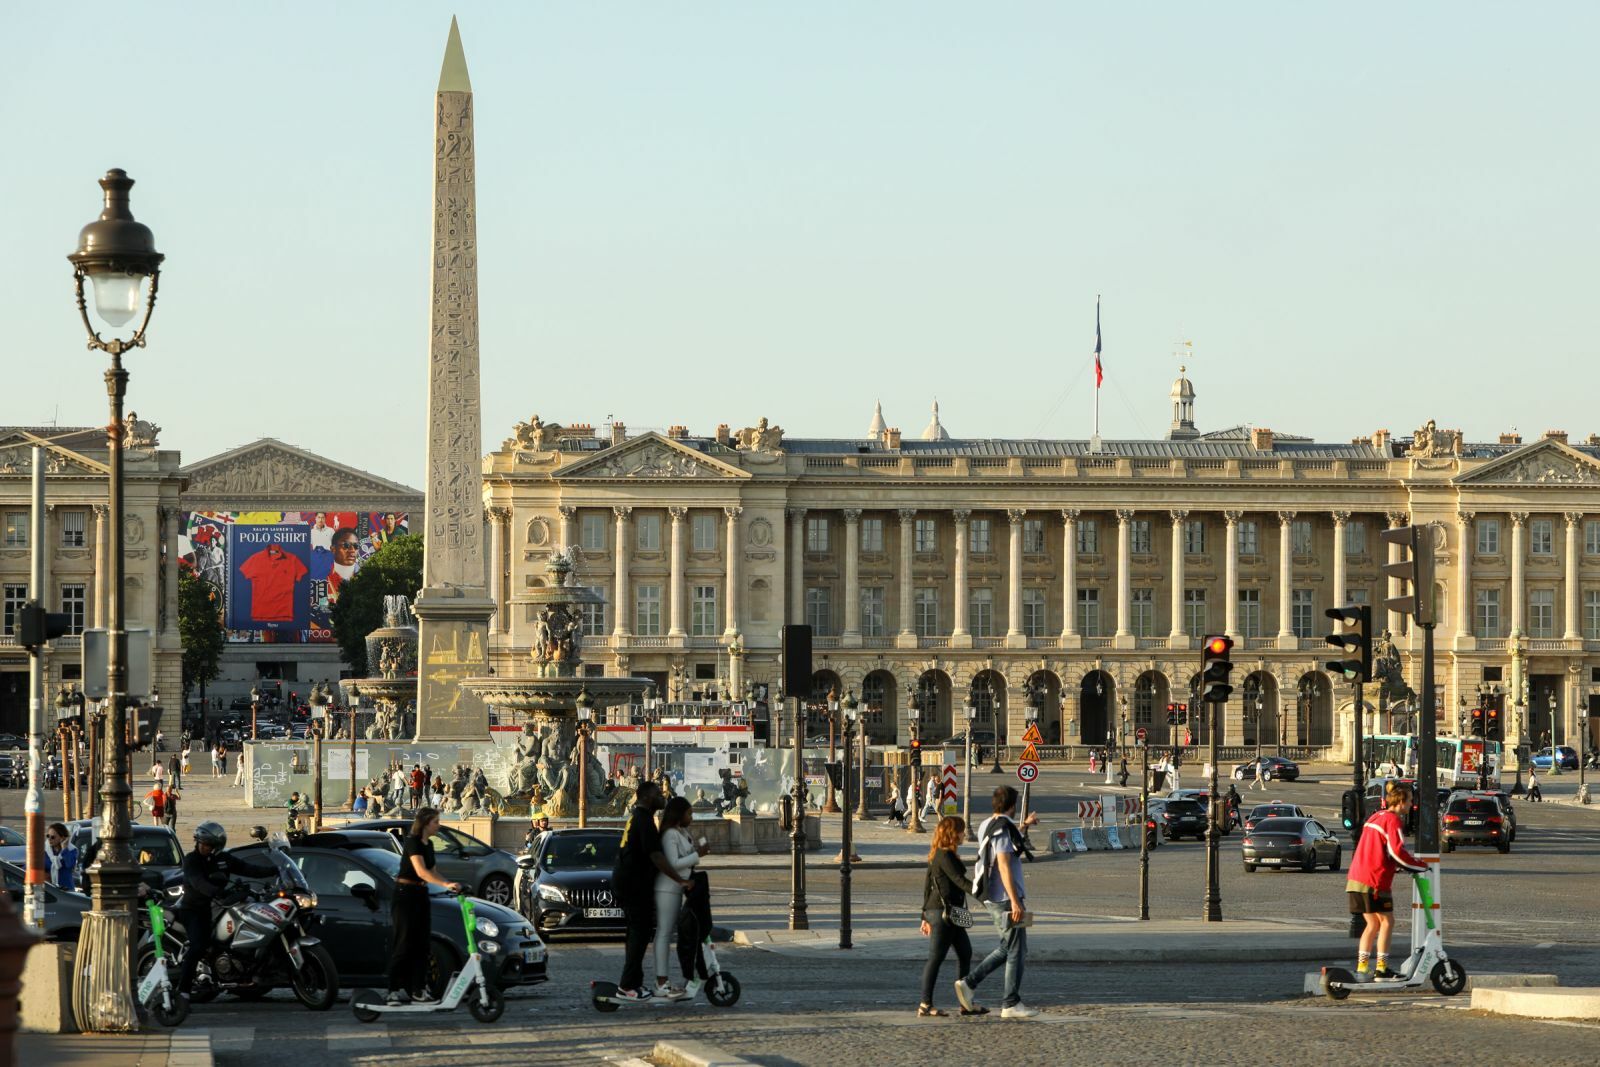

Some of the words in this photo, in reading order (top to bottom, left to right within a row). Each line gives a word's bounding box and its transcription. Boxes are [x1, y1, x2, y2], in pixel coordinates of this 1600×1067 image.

[239, 532, 271, 543] POLO
[273, 532, 307, 543] SHIRT
[308, 629, 331, 638] POLO
[1022, 768, 1034, 777] 30
[140, 980, 153, 1000] ime
